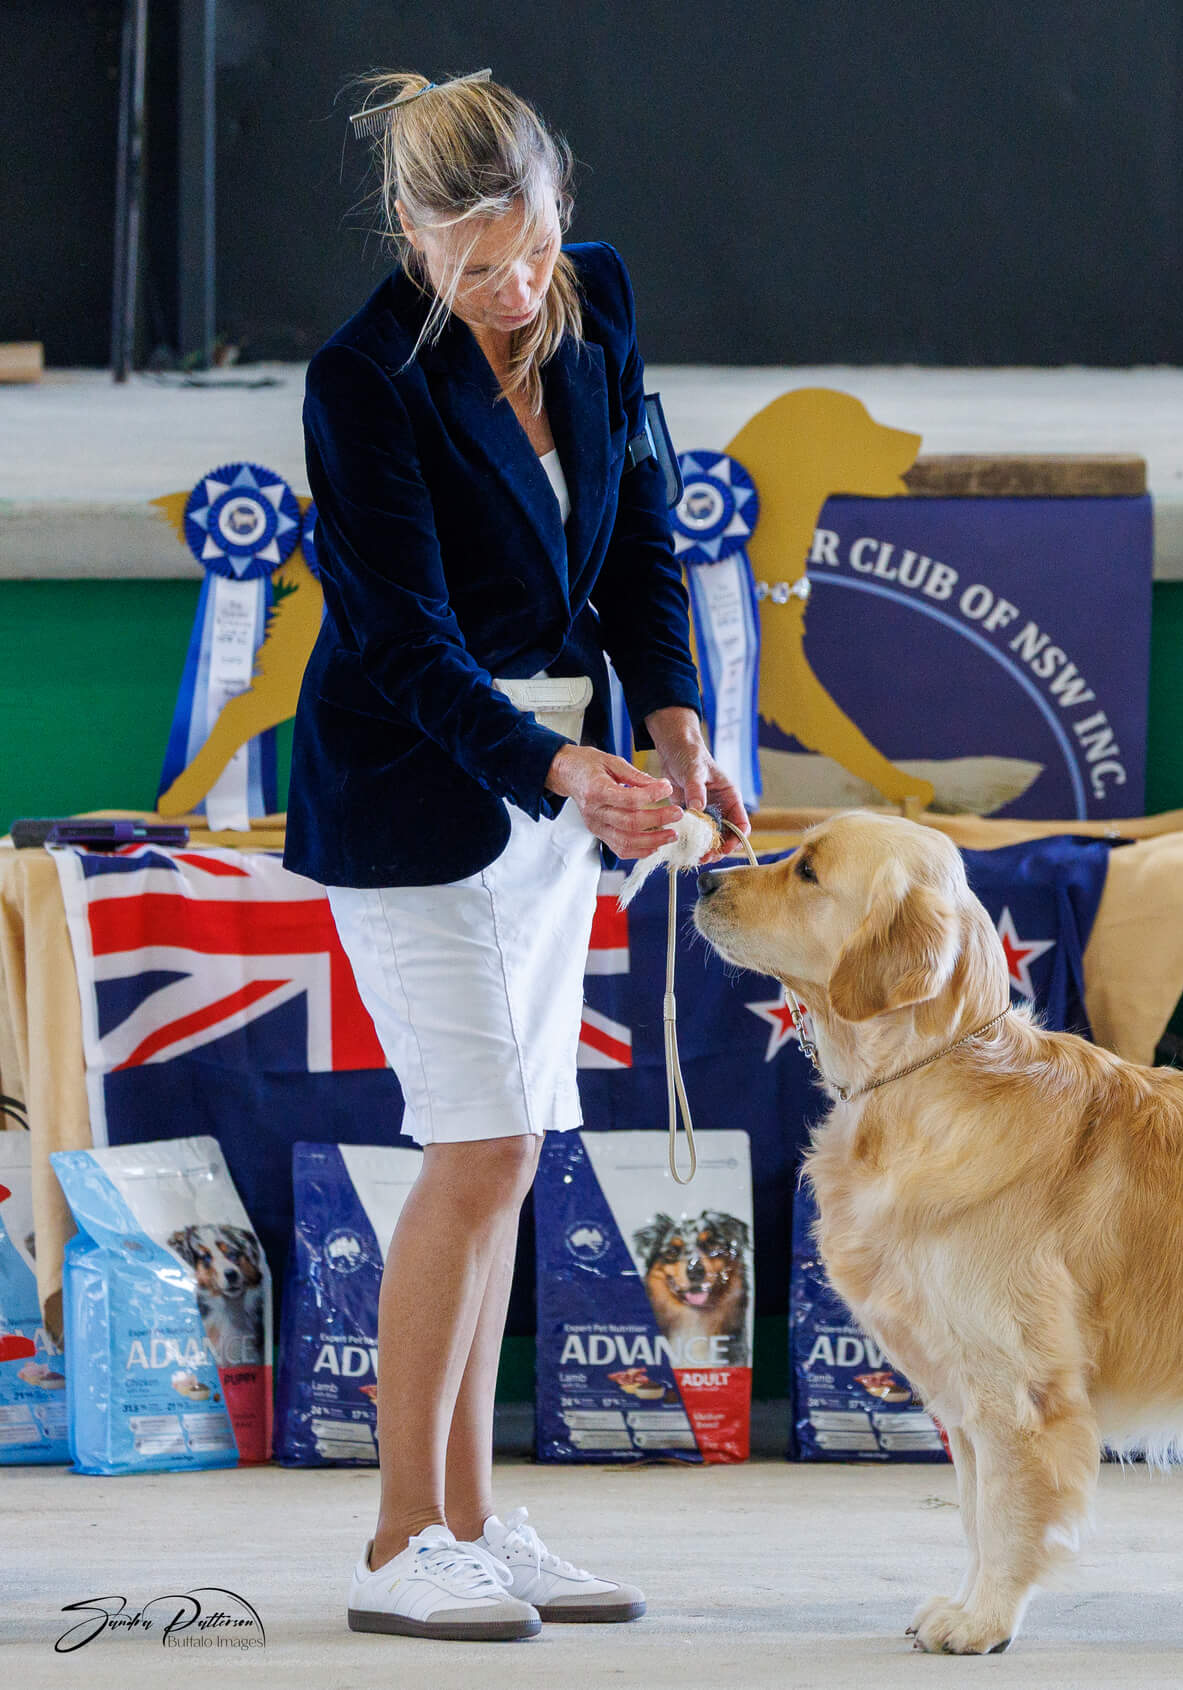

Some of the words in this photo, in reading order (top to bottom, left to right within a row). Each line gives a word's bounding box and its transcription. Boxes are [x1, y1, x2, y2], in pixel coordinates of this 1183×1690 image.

[849, 536, 960, 601] CLUB
[959, 583, 1020, 634] OF
[1009, 620, 1098, 709] NSW
[1072, 709, 1128, 800] INC.
[564, 1323, 592, 1334] Expert
[609, 1323, 648, 1333] Nutrition
[125, 1335, 257, 1369] ADVANCE
[560, 1334, 731, 1366] ADVANCE
[559, 1373, 587, 1384] Lamb
[681, 1372, 731, 1386] ADULT
